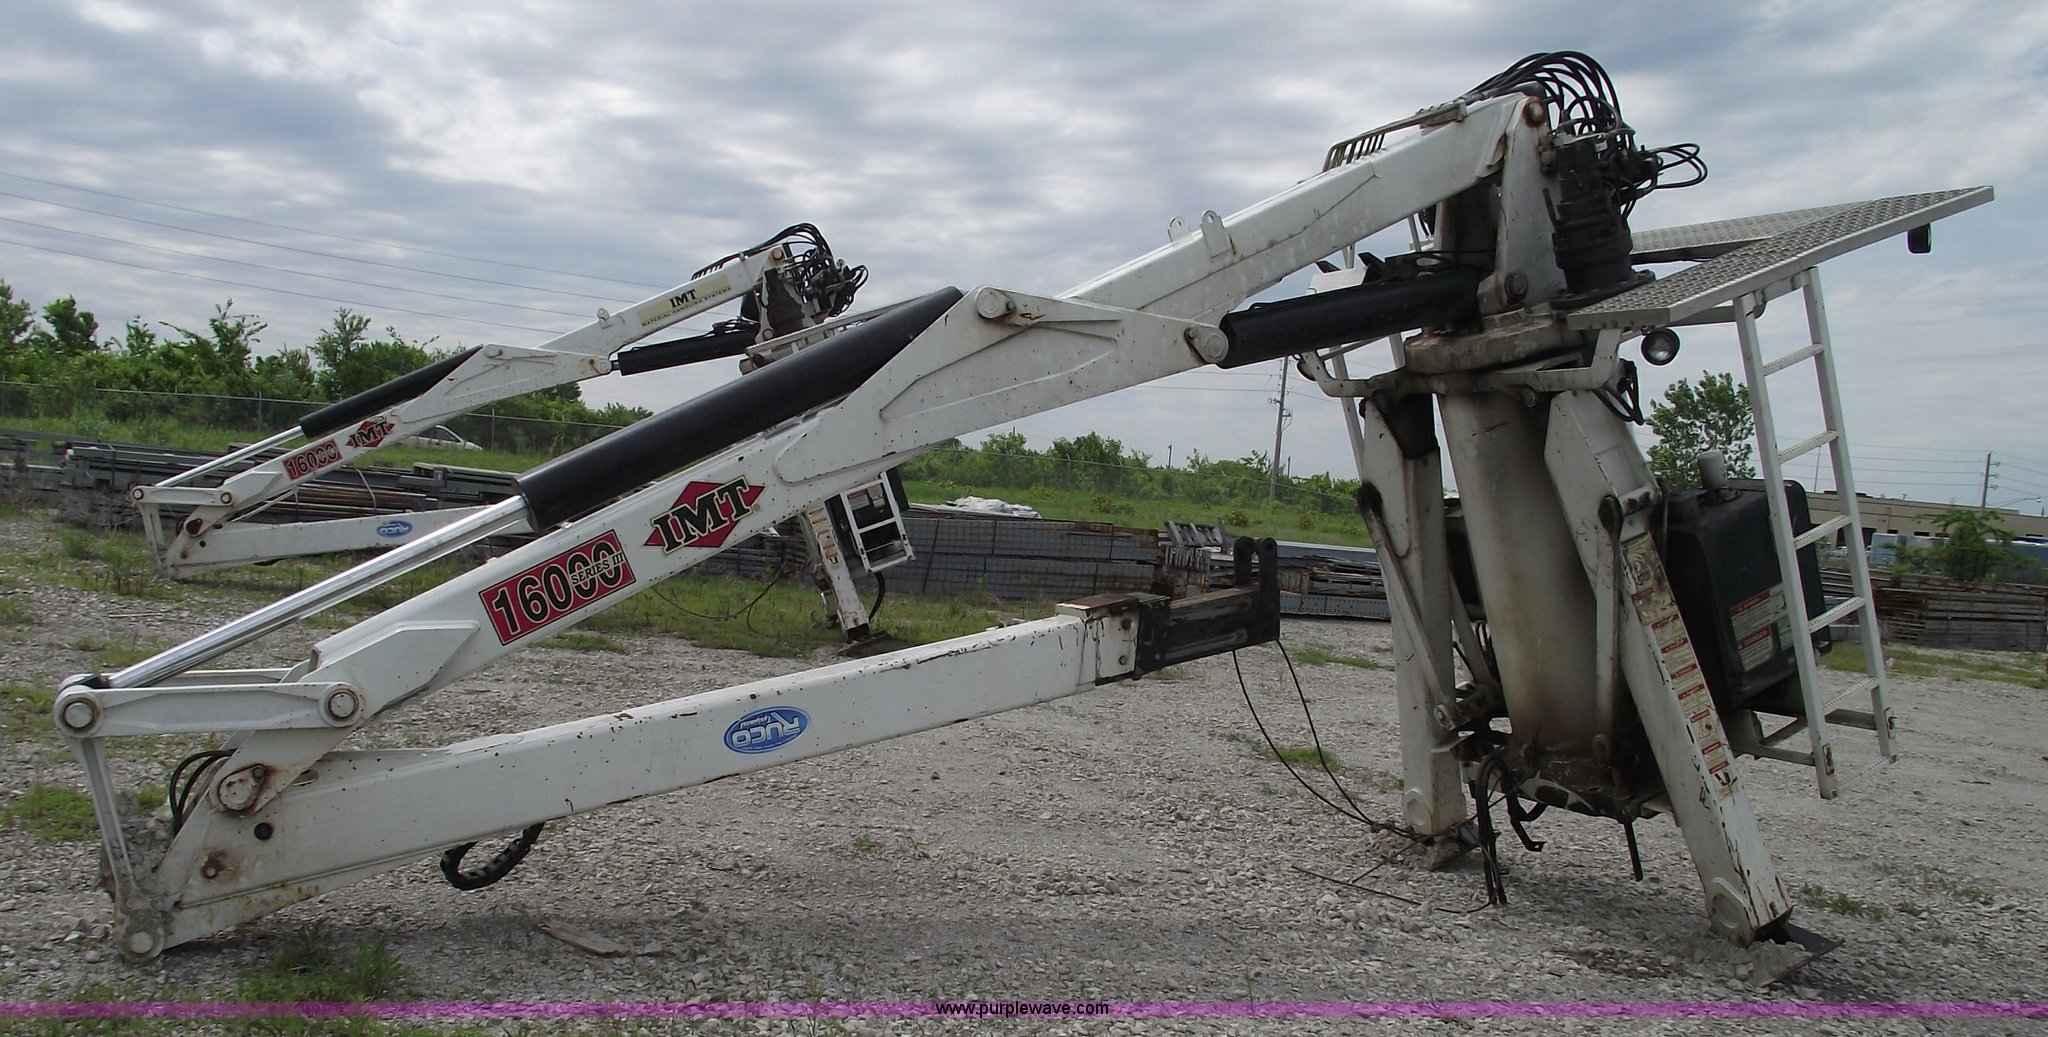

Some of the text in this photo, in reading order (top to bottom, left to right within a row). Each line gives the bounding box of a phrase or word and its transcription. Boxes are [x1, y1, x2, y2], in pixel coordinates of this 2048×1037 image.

[669, 289, 697, 309] IMT
[641, 313, 671, 327] MATERIAL
[349, 421, 391, 448] IMT
[286, 442, 337, 478] 16000
[651, 476, 753, 554] IMT
[570, 551, 626, 585] SERIES III
[491, 541, 624, 636] 16000
[731, 711, 801, 748] RUCO
